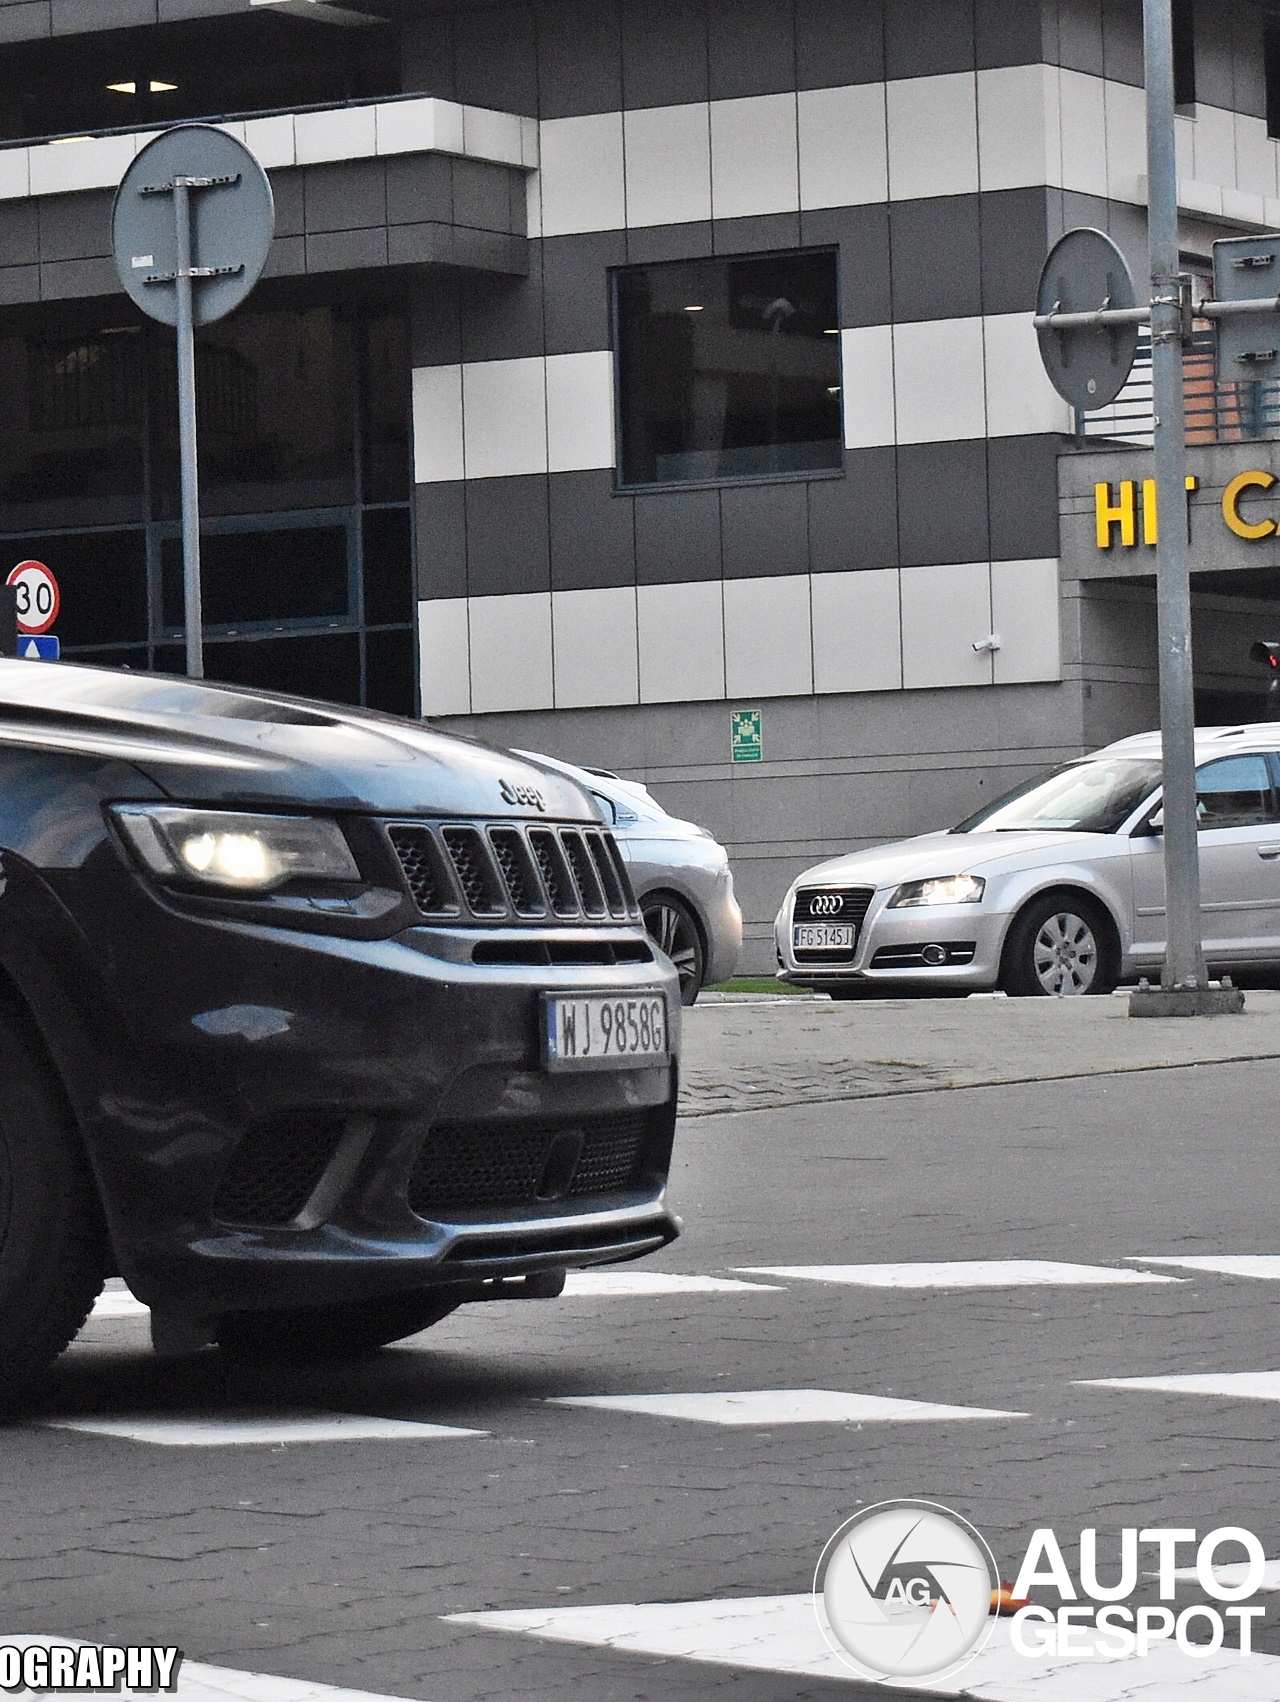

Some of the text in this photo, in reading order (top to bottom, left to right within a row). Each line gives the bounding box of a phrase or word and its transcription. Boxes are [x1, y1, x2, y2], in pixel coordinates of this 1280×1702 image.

[1095, 469, 1280, 548] HI C
[16, 581, 52, 615] 30
[498, 778, 546, 812] Jeep
[801, 928, 850, 946] FG 5145J
[562, 1001, 662, 1056] WJ 9858G
